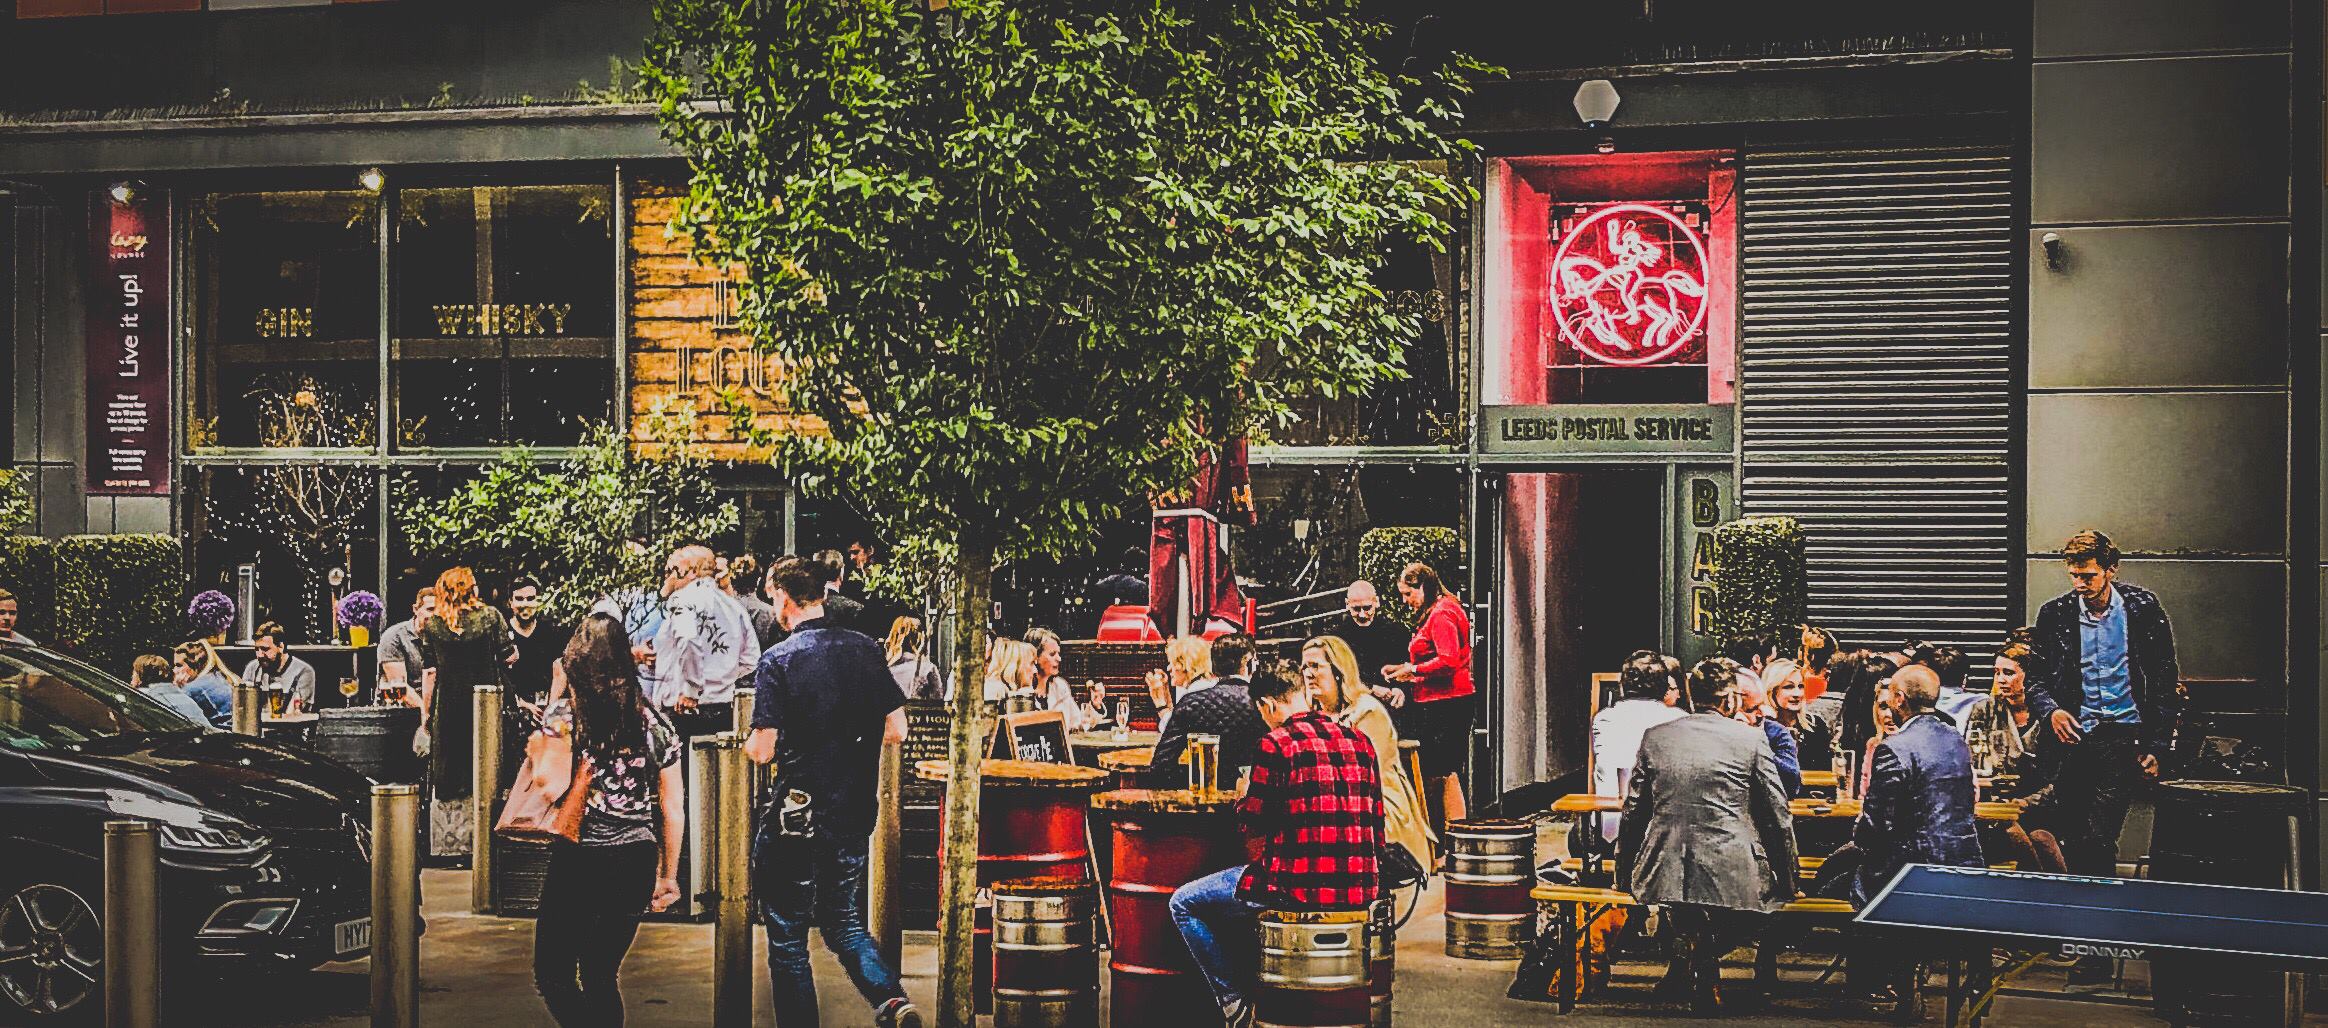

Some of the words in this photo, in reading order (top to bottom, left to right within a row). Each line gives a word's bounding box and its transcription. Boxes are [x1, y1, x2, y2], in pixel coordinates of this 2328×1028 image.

[118, 273, 144, 307] up!
[119, 312, 140, 328] it
[255, 307, 312, 338] GIN
[432, 302, 571, 336] WHISKY
[118, 334, 140, 378] Live
[1501, 416, 1558, 441] LEEDS
[1562, 416, 1630, 441] POSTAL
[1633, 415, 1713, 441] SERVICE
[1690, 477, 1721, 636] BAR
[2061, 943, 2145, 959] DONNAY
